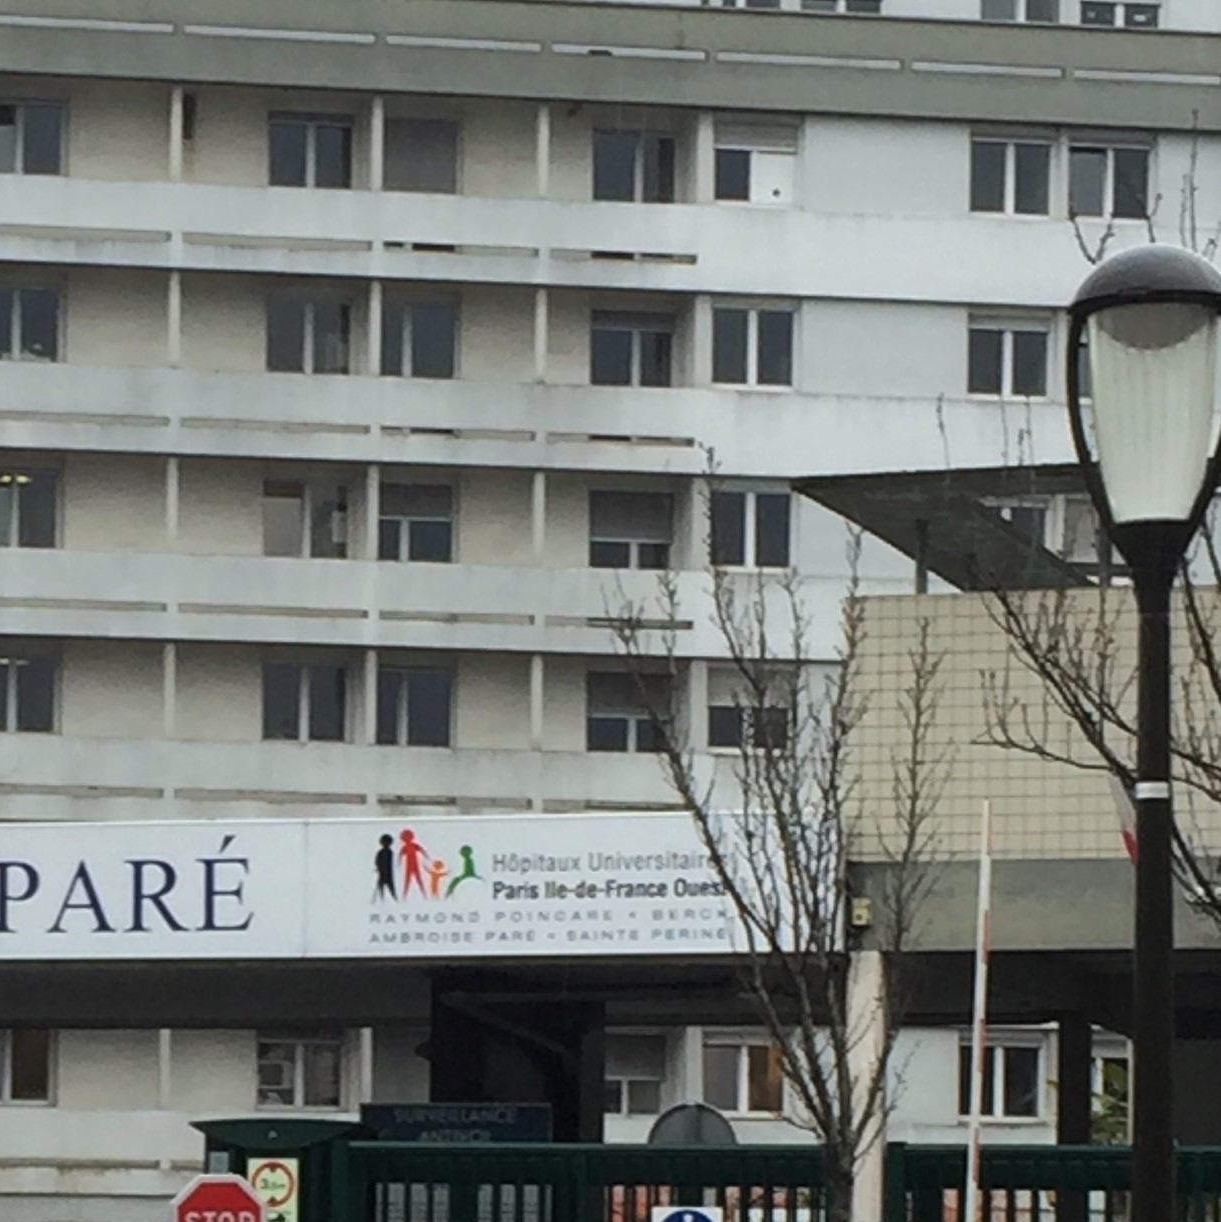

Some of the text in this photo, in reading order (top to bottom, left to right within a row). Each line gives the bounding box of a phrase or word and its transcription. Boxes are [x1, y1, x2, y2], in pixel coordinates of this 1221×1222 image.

[492, 850, 728, 876] Hôpitaux Universitair
[492, 880, 539, 900] Paris
[544, 878, 667, 899] Ile-de-France
[369, 911, 481, 924] RAYMOND
[369, 931, 474, 944] AMBROISE
[566, 929, 639, 942] SAINTE
